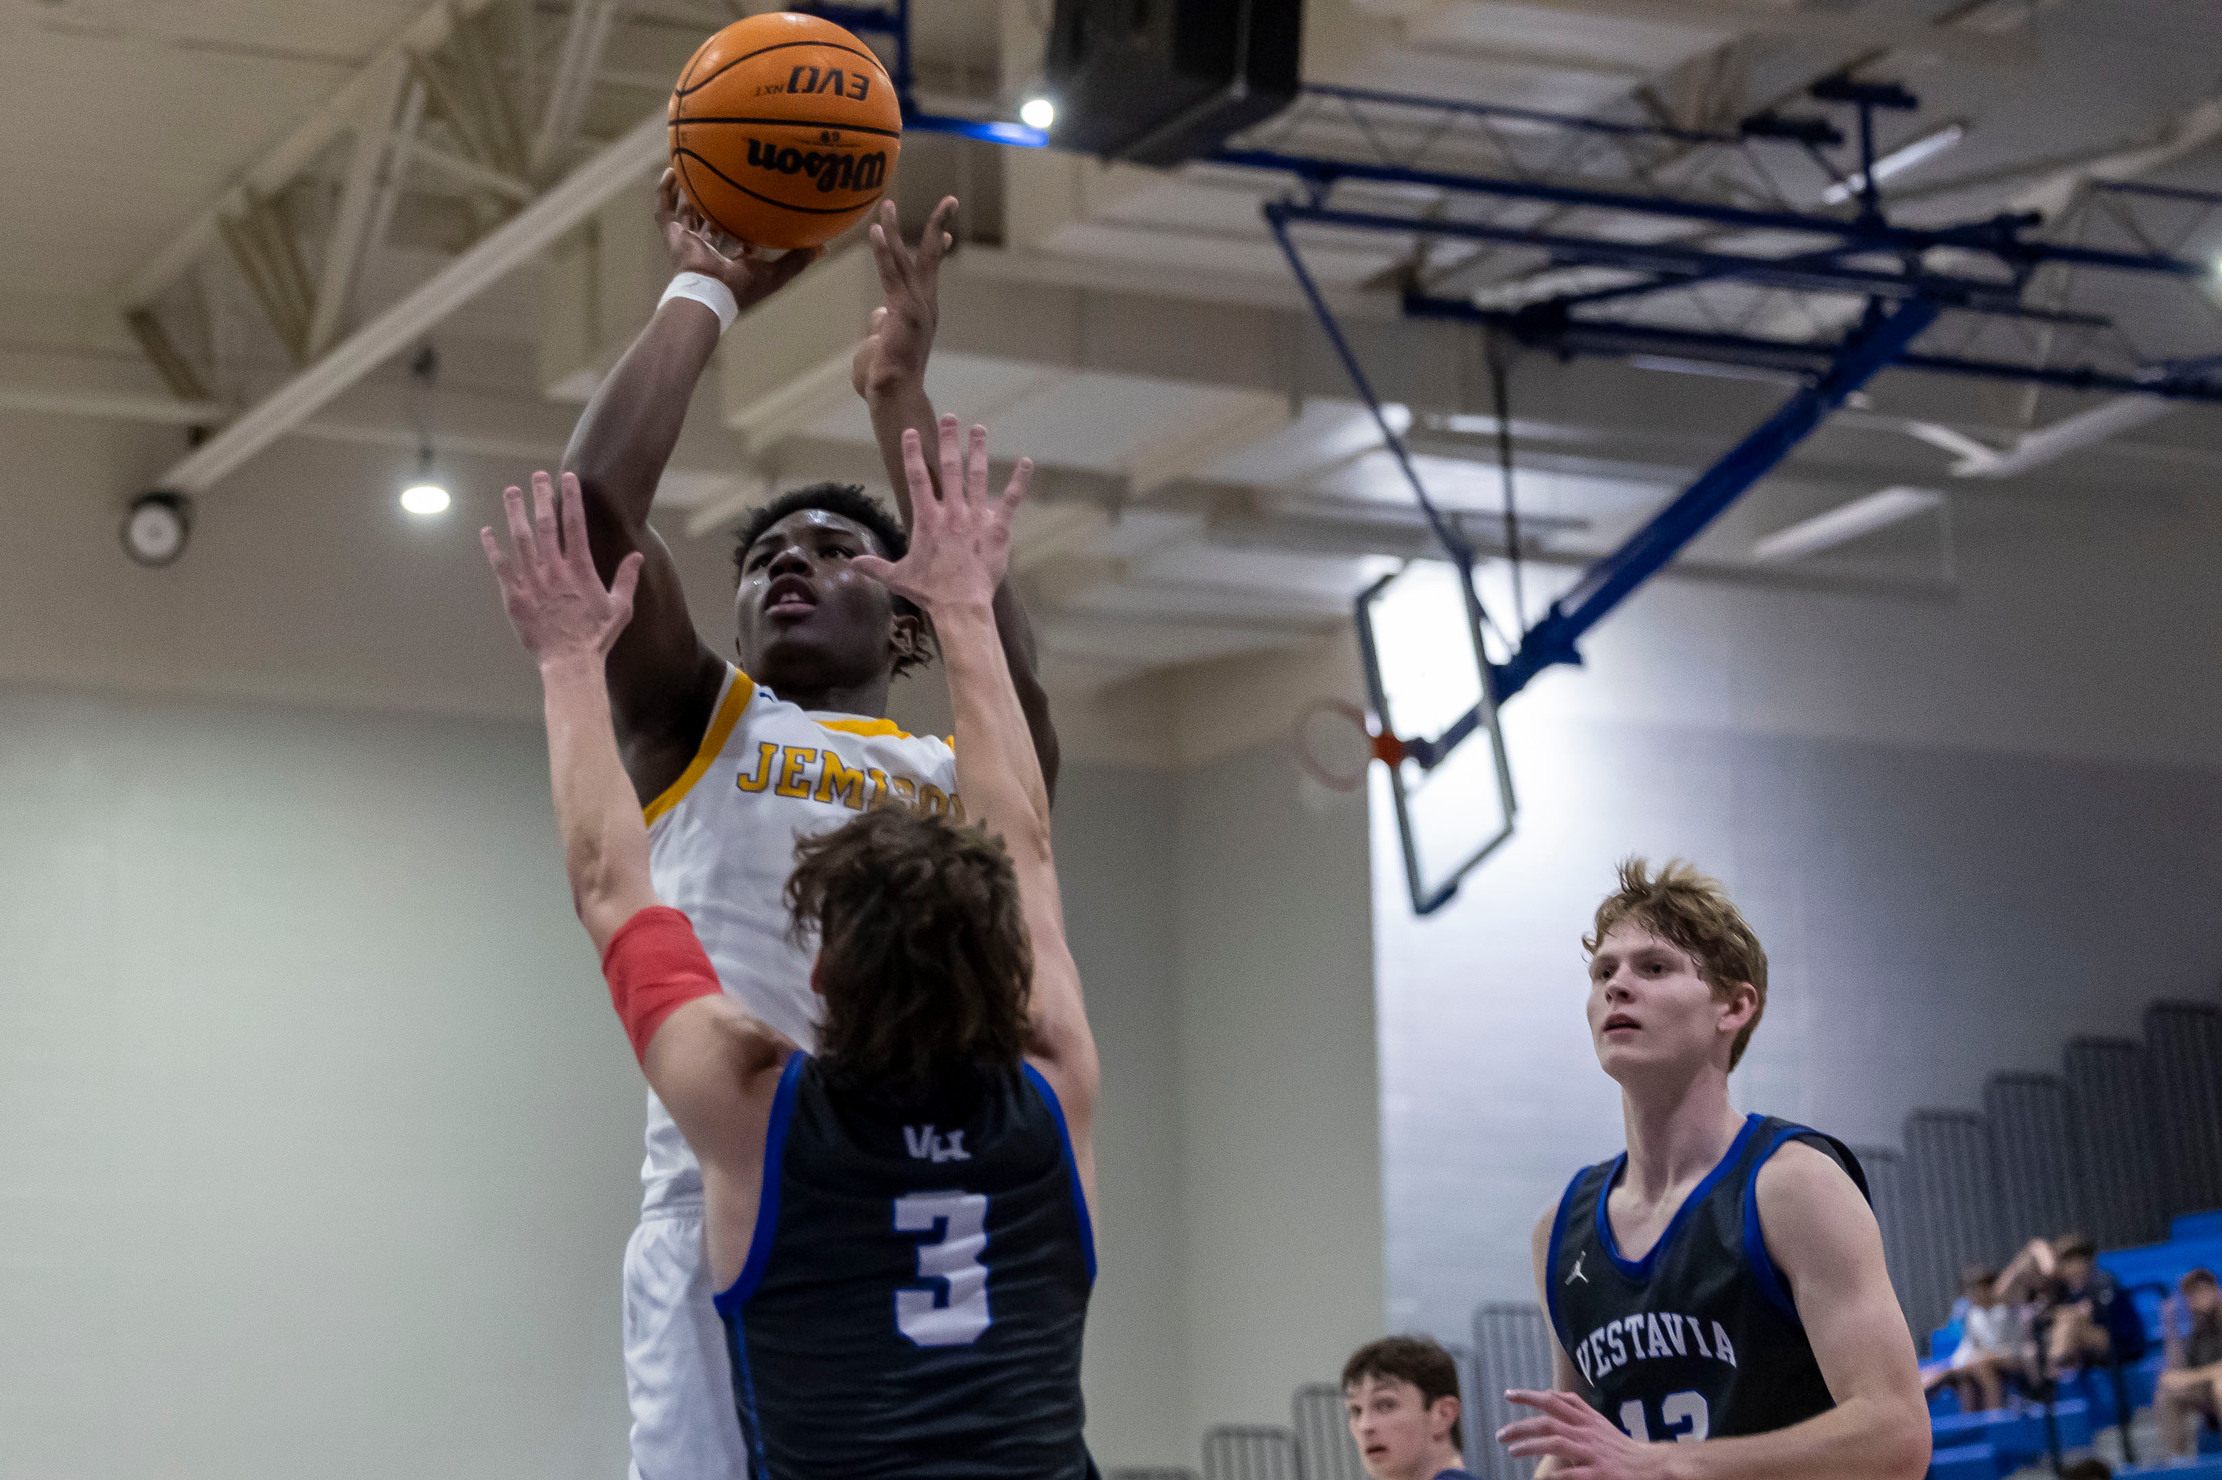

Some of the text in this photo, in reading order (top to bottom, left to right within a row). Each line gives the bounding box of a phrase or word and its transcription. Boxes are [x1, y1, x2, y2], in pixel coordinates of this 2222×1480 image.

[786, 66, 870, 101] EVO
[746, 137, 886, 193] Wilson
[892, 1188, 993, 1347] 3
[1575, 1311, 1737, 1388] VESTAVIA
